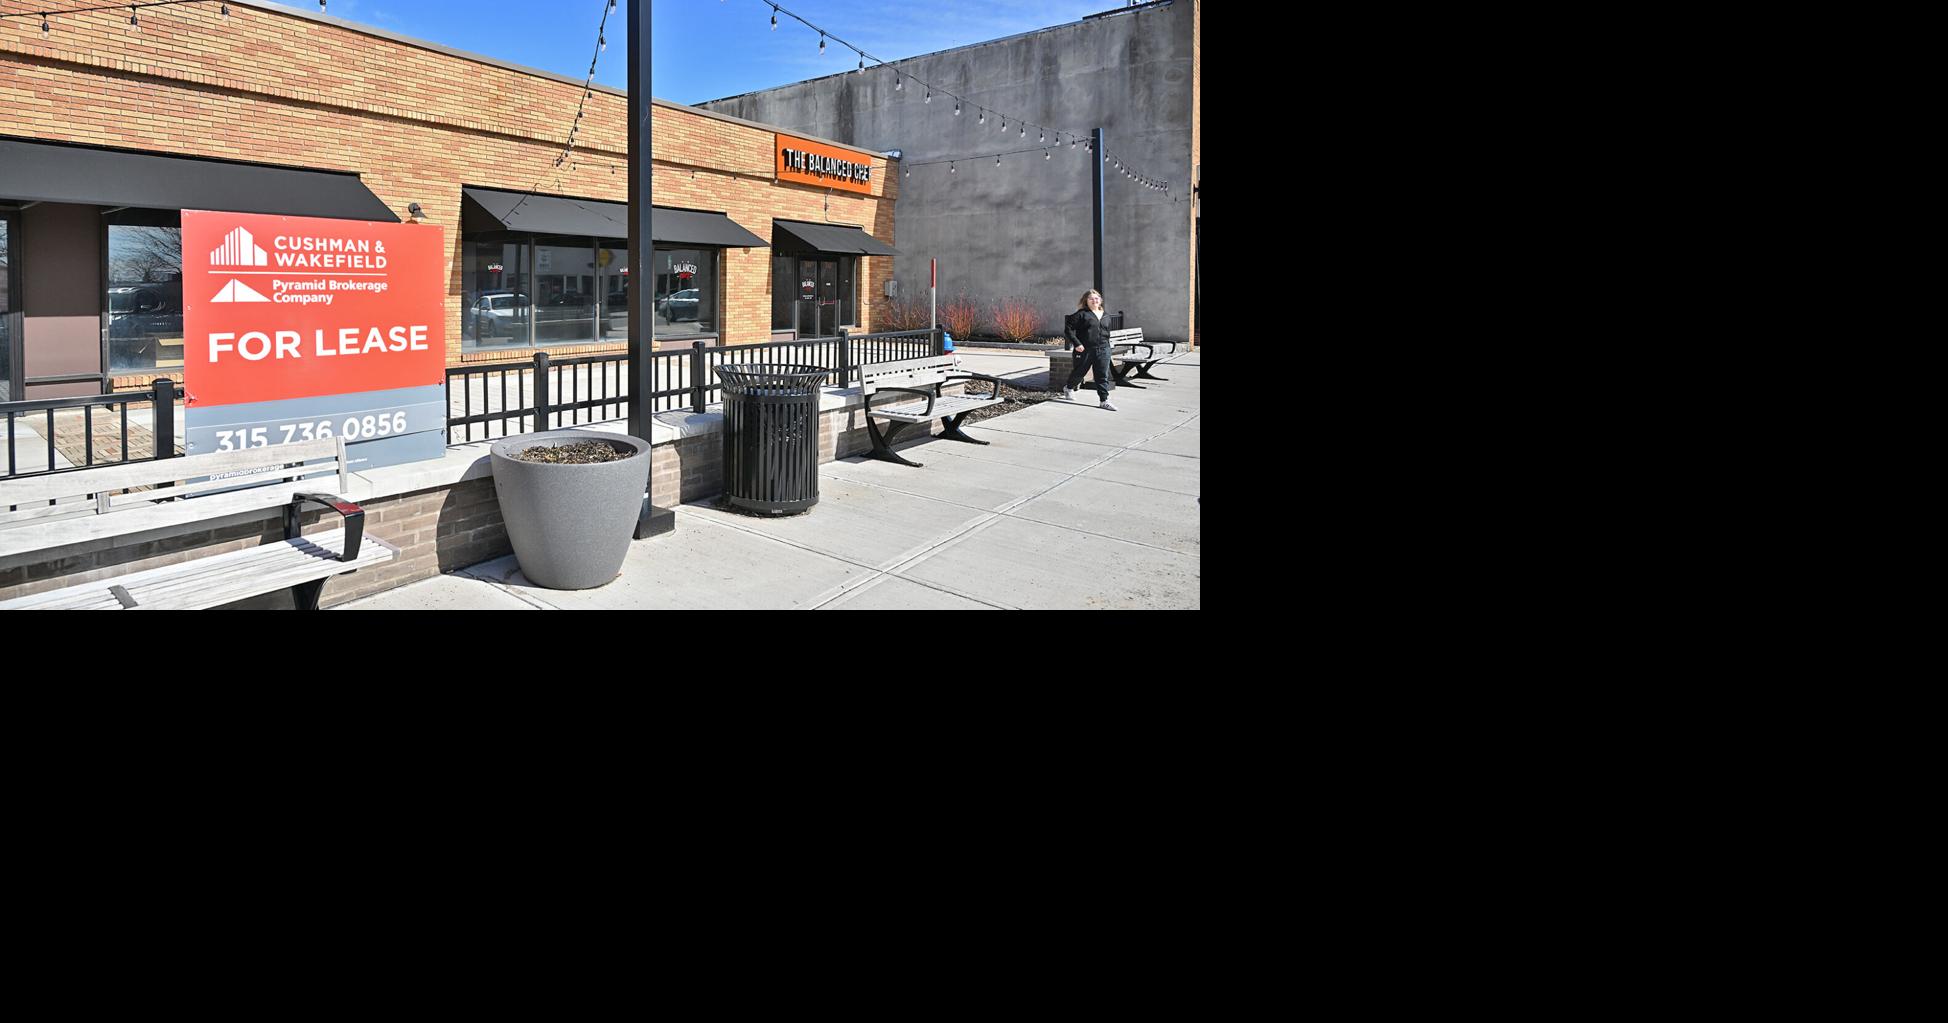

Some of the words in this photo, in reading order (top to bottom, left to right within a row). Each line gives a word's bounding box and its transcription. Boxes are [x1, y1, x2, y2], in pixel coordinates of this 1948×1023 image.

[786, 148, 806, 169] THE
[808, 153, 852, 178] BALANCED
[274, 236, 369, 253] CUSHMAN
[375, 240, 386, 253] &
[274, 252, 387, 269] WAKEFIELD
[673, 263, 697, 275] BALANCED
[272, 279, 326, 292] Pyramid
[328, 280, 388, 293] Brokerage
[272, 292, 334, 305] Company
[208, 331, 302, 363] FOR
[315, 325, 428, 357] LEASE
[342, 411, 407, 440] 0856
